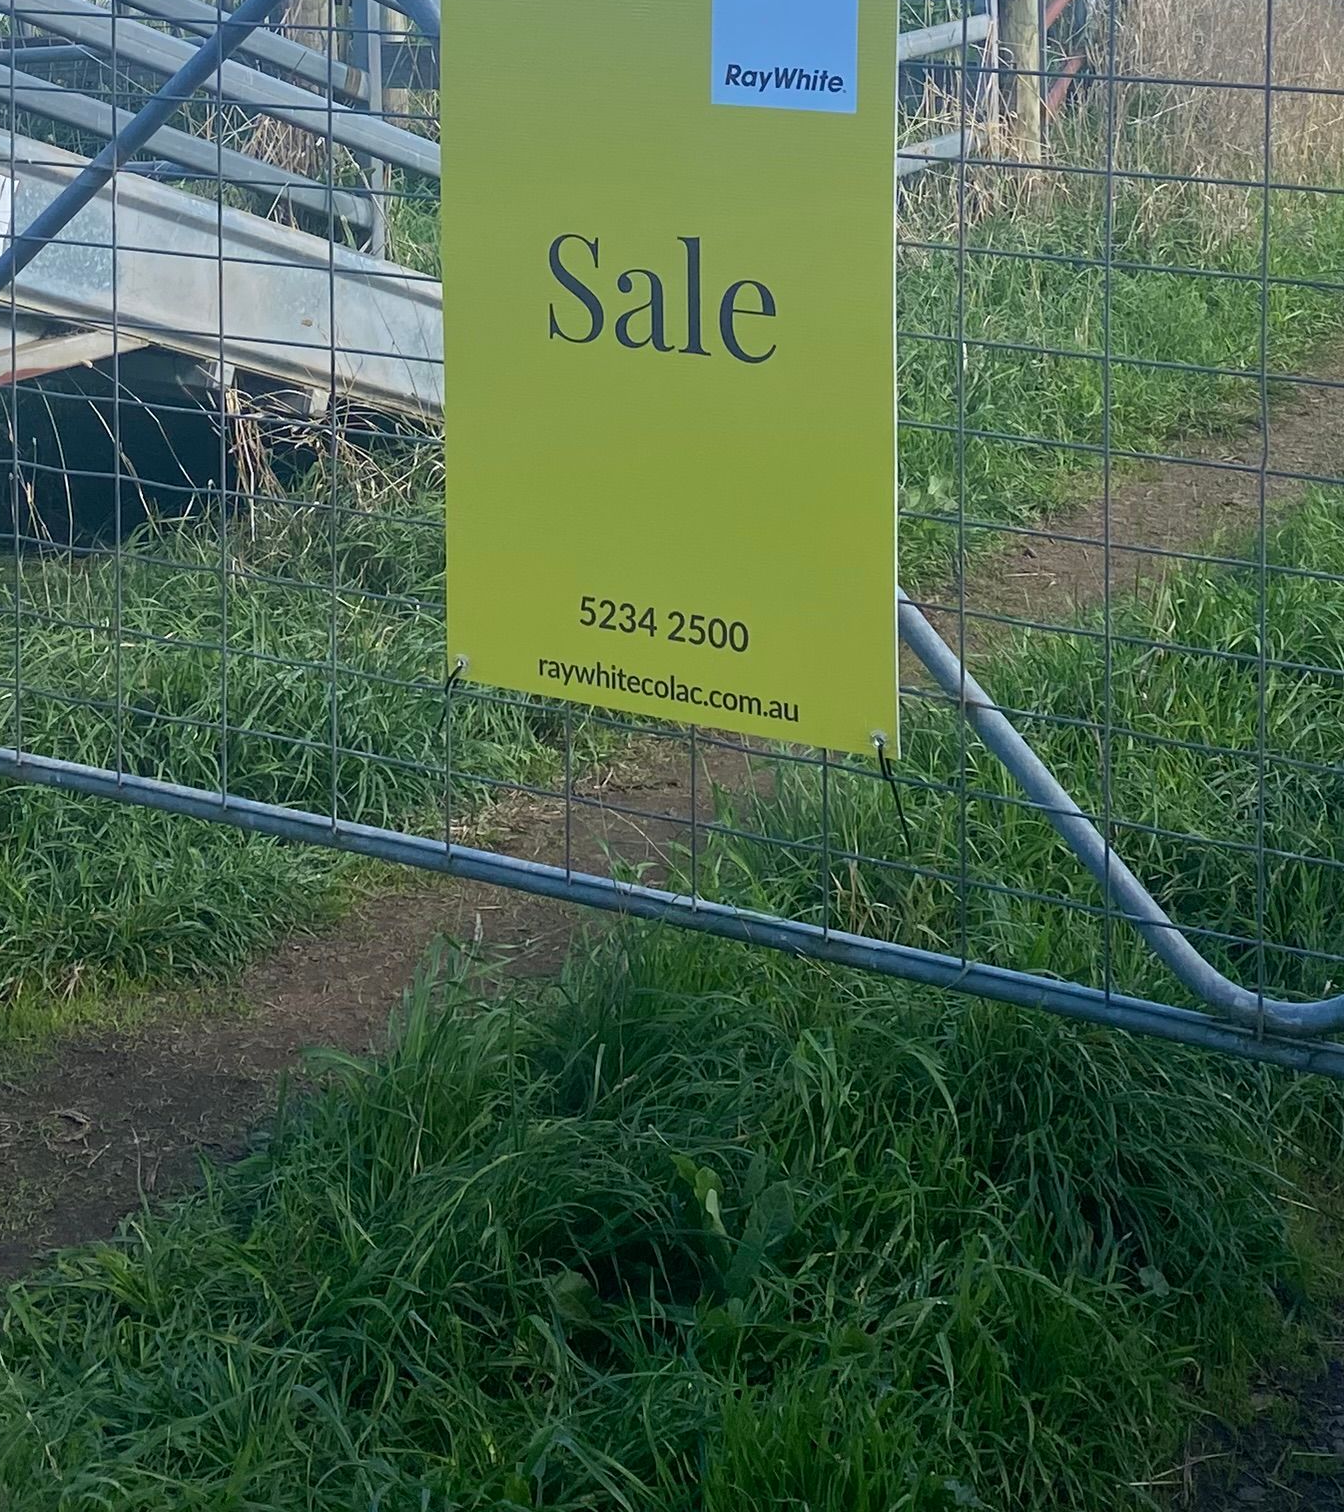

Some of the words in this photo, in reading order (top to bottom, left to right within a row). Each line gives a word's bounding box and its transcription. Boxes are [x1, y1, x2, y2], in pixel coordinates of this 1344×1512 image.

[548, 233, 778, 365] Sale
[579, 595, 658, 637] 5234
[667, 610, 749, 652] 2500
[539, 658, 800, 723] raywhitecolac.com.au
